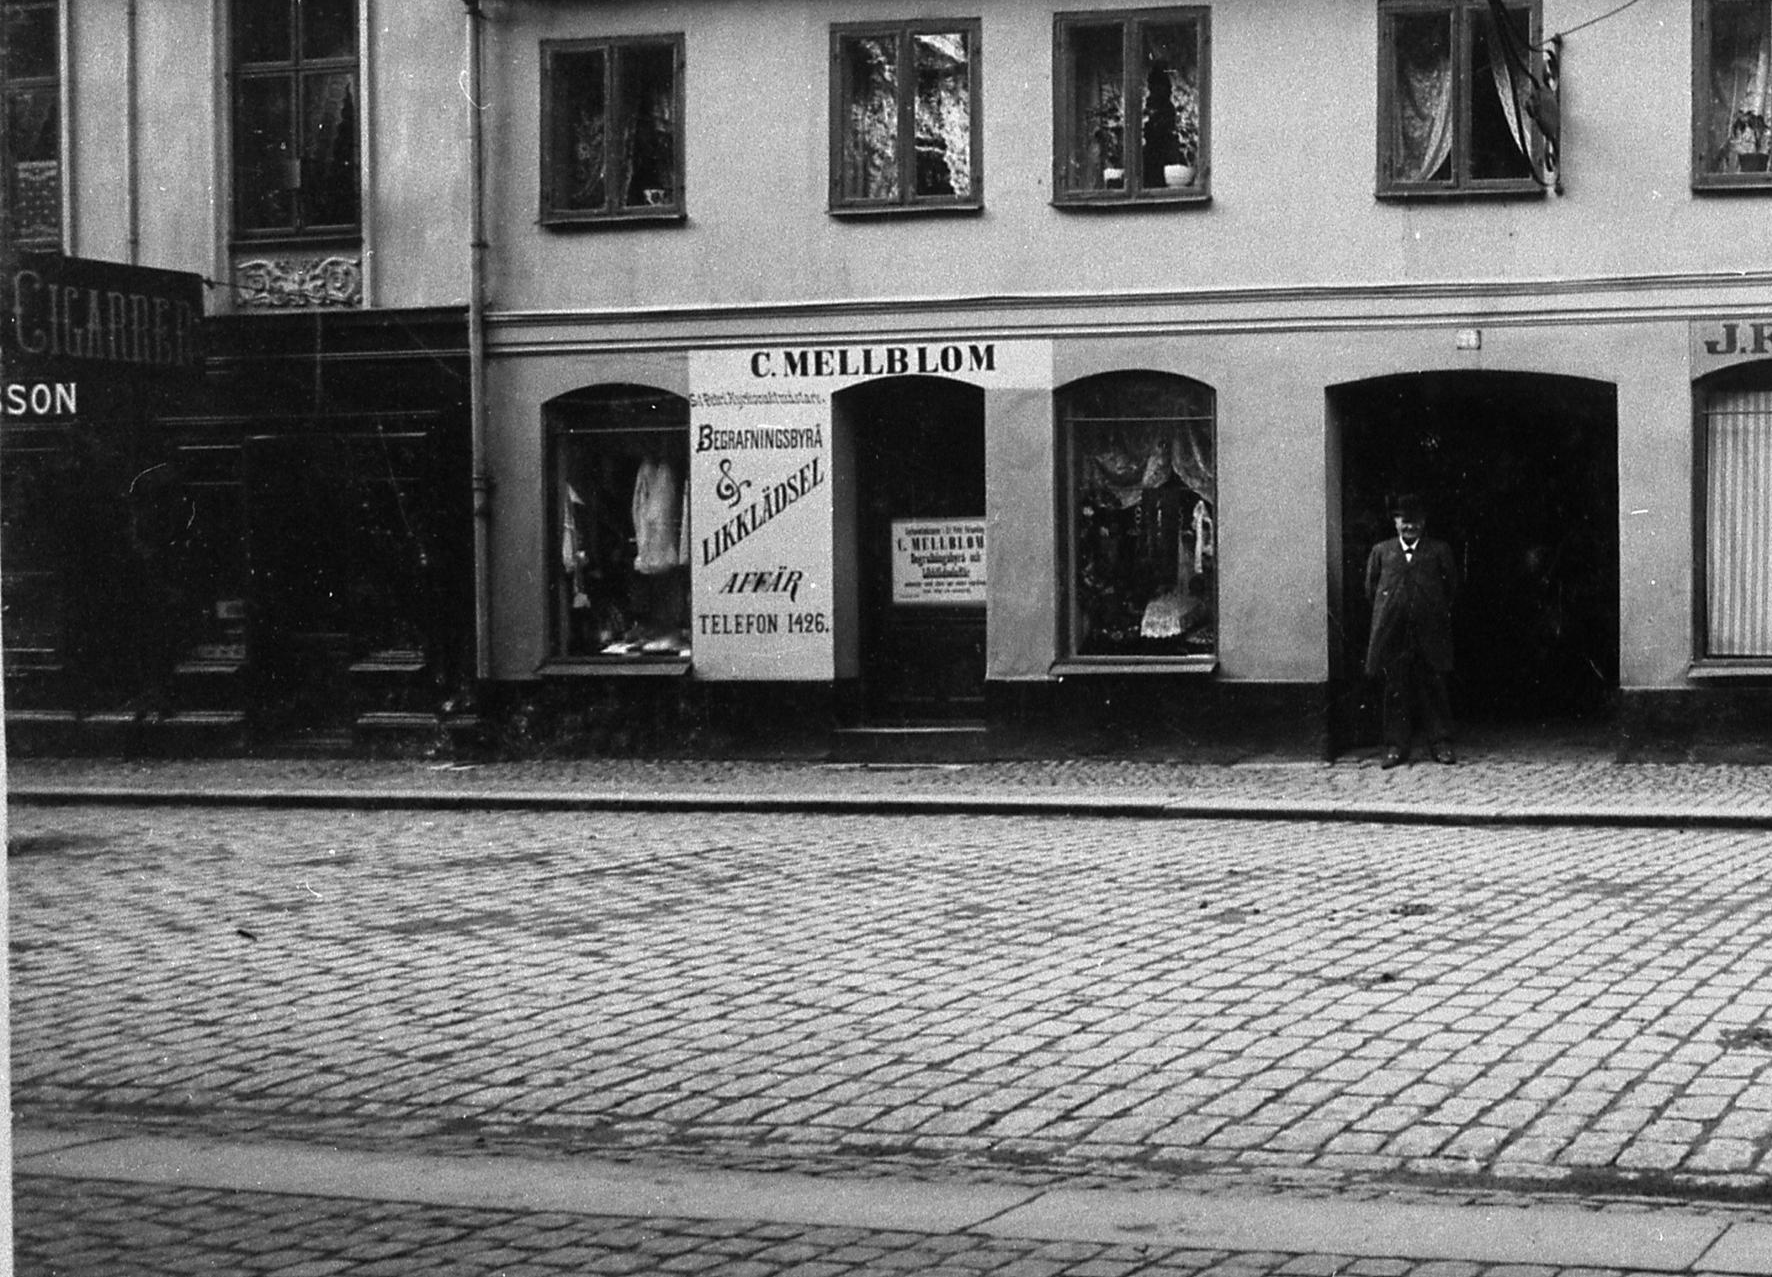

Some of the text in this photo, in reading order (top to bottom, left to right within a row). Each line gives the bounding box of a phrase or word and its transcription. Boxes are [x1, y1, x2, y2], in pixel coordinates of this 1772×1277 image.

[751, 344, 996, 378] C. MELLBLOM
[716, 459, 752, 508] &
[702, 457, 824, 566] LIKKLÄDSEL
[720, 566, 803, 602] AFFÄR
[699, 612, 779, 635] TELEFON
